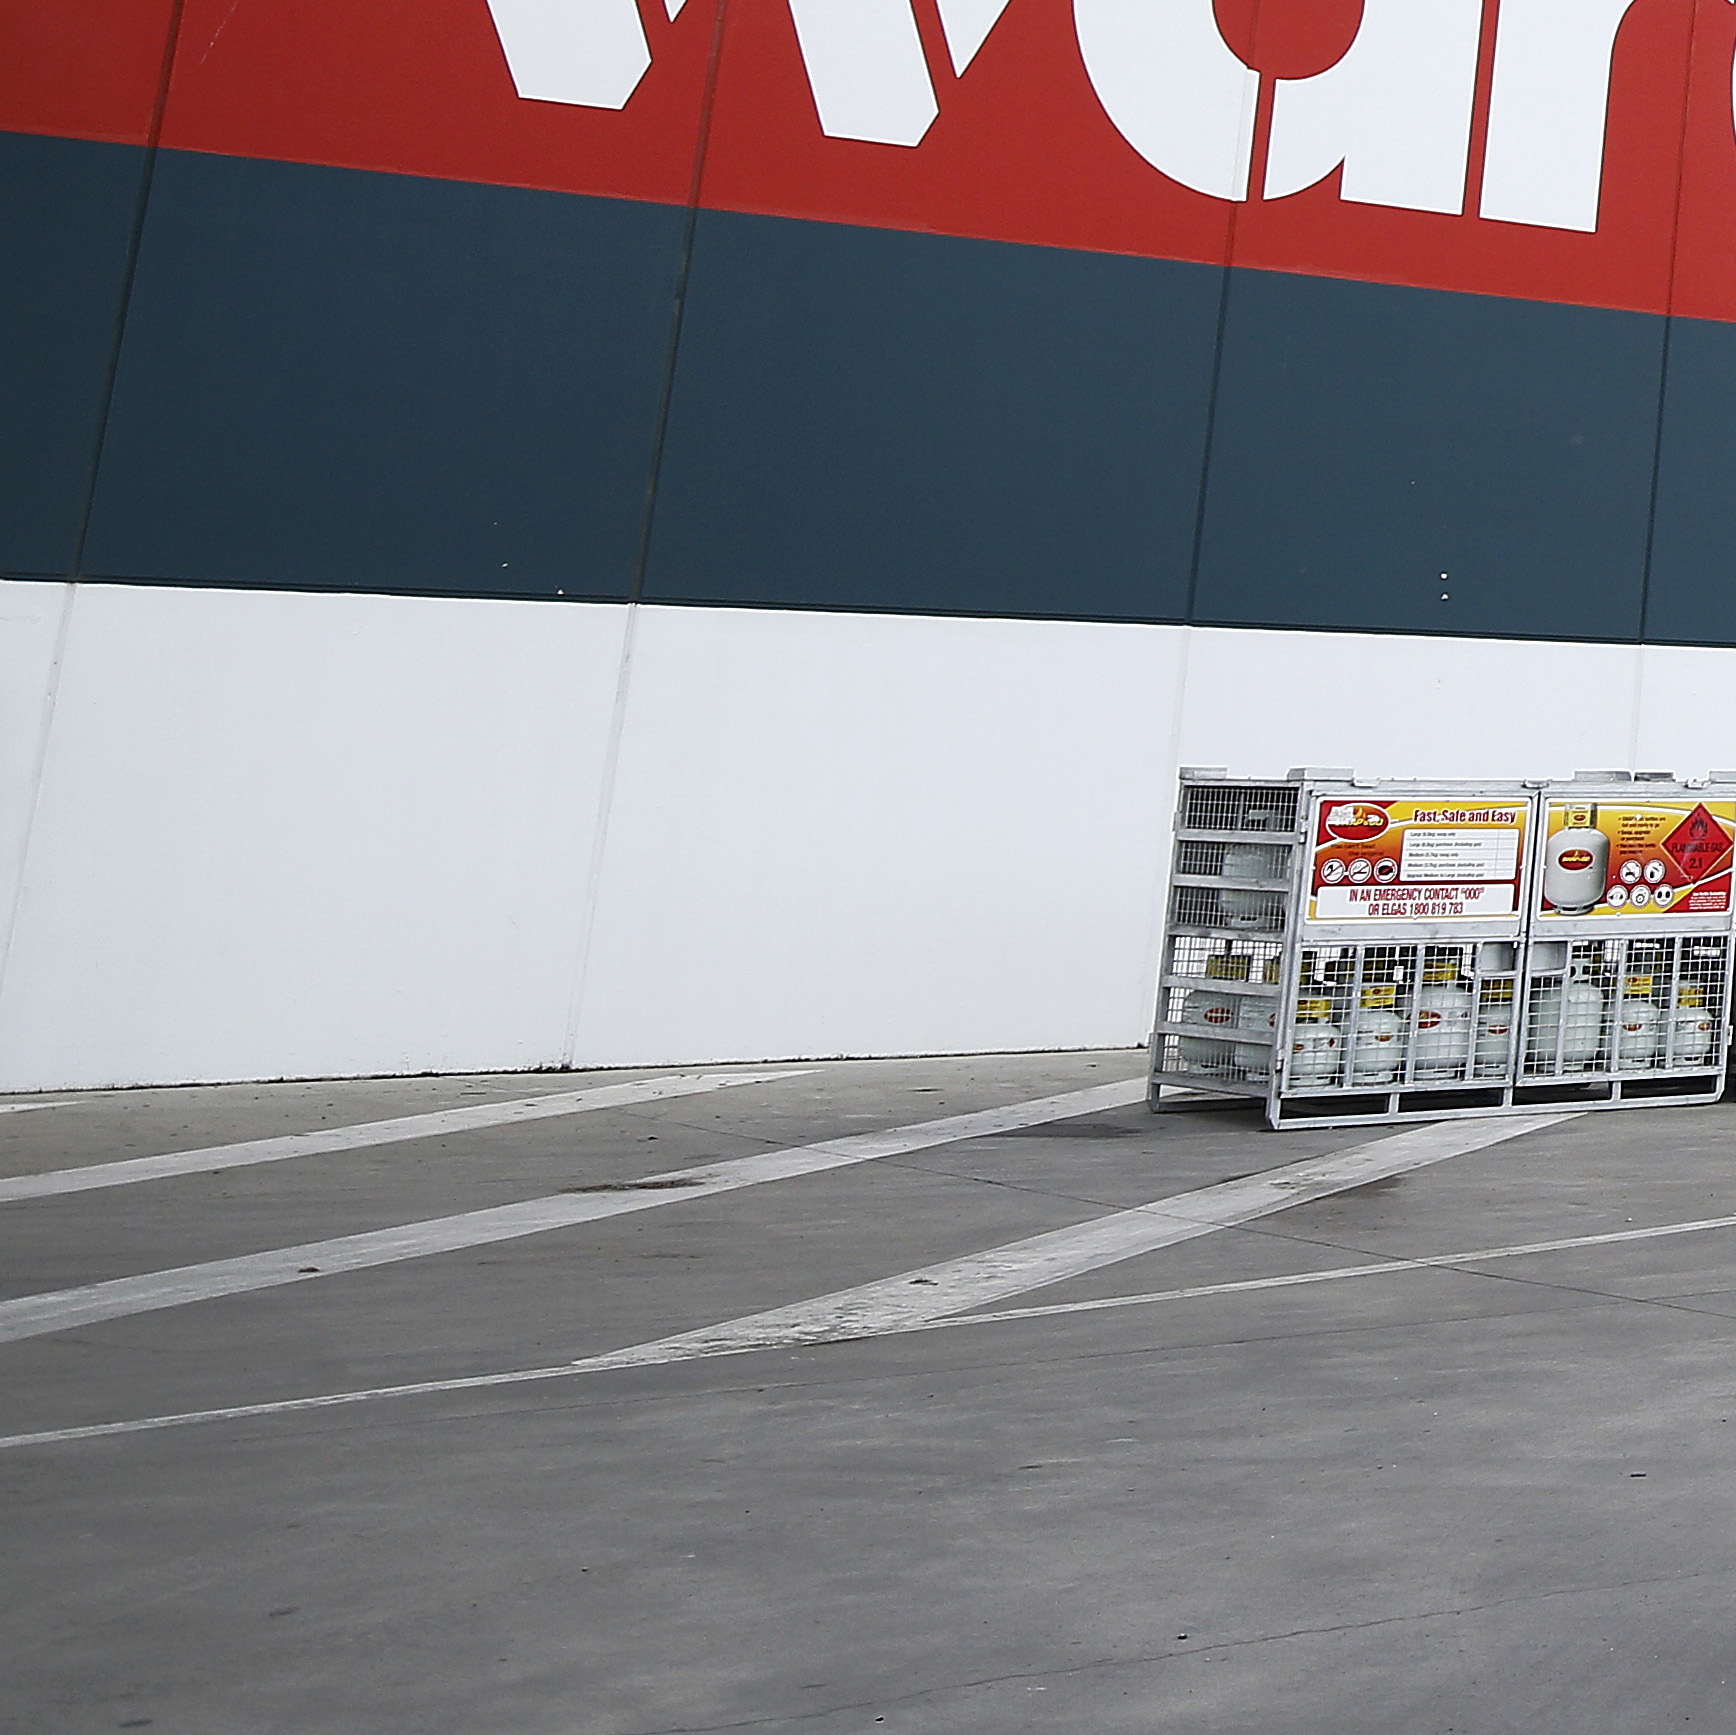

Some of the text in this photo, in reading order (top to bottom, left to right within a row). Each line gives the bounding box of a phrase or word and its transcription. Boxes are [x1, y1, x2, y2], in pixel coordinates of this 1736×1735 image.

[1442, 810, 1466, 822] Safe
[1468, 809, 1488, 822] and
[1491, 809, 1516, 824] Easy
[1689, 858, 1703, 870] 2.1
[1349, 890, 1358, 902] IN
[1359, 889, 1371, 902] AN
[1373, 888, 1422, 901] EMERGENCY
[1424, 888, 1459, 900] CONTACT
[1368, 903, 1380, 916] OR
[1382, 903, 1408, 916] ELGAS
[1410, 903, 1430, 914] 1800
[1431, 903, 1447, 914] 819
